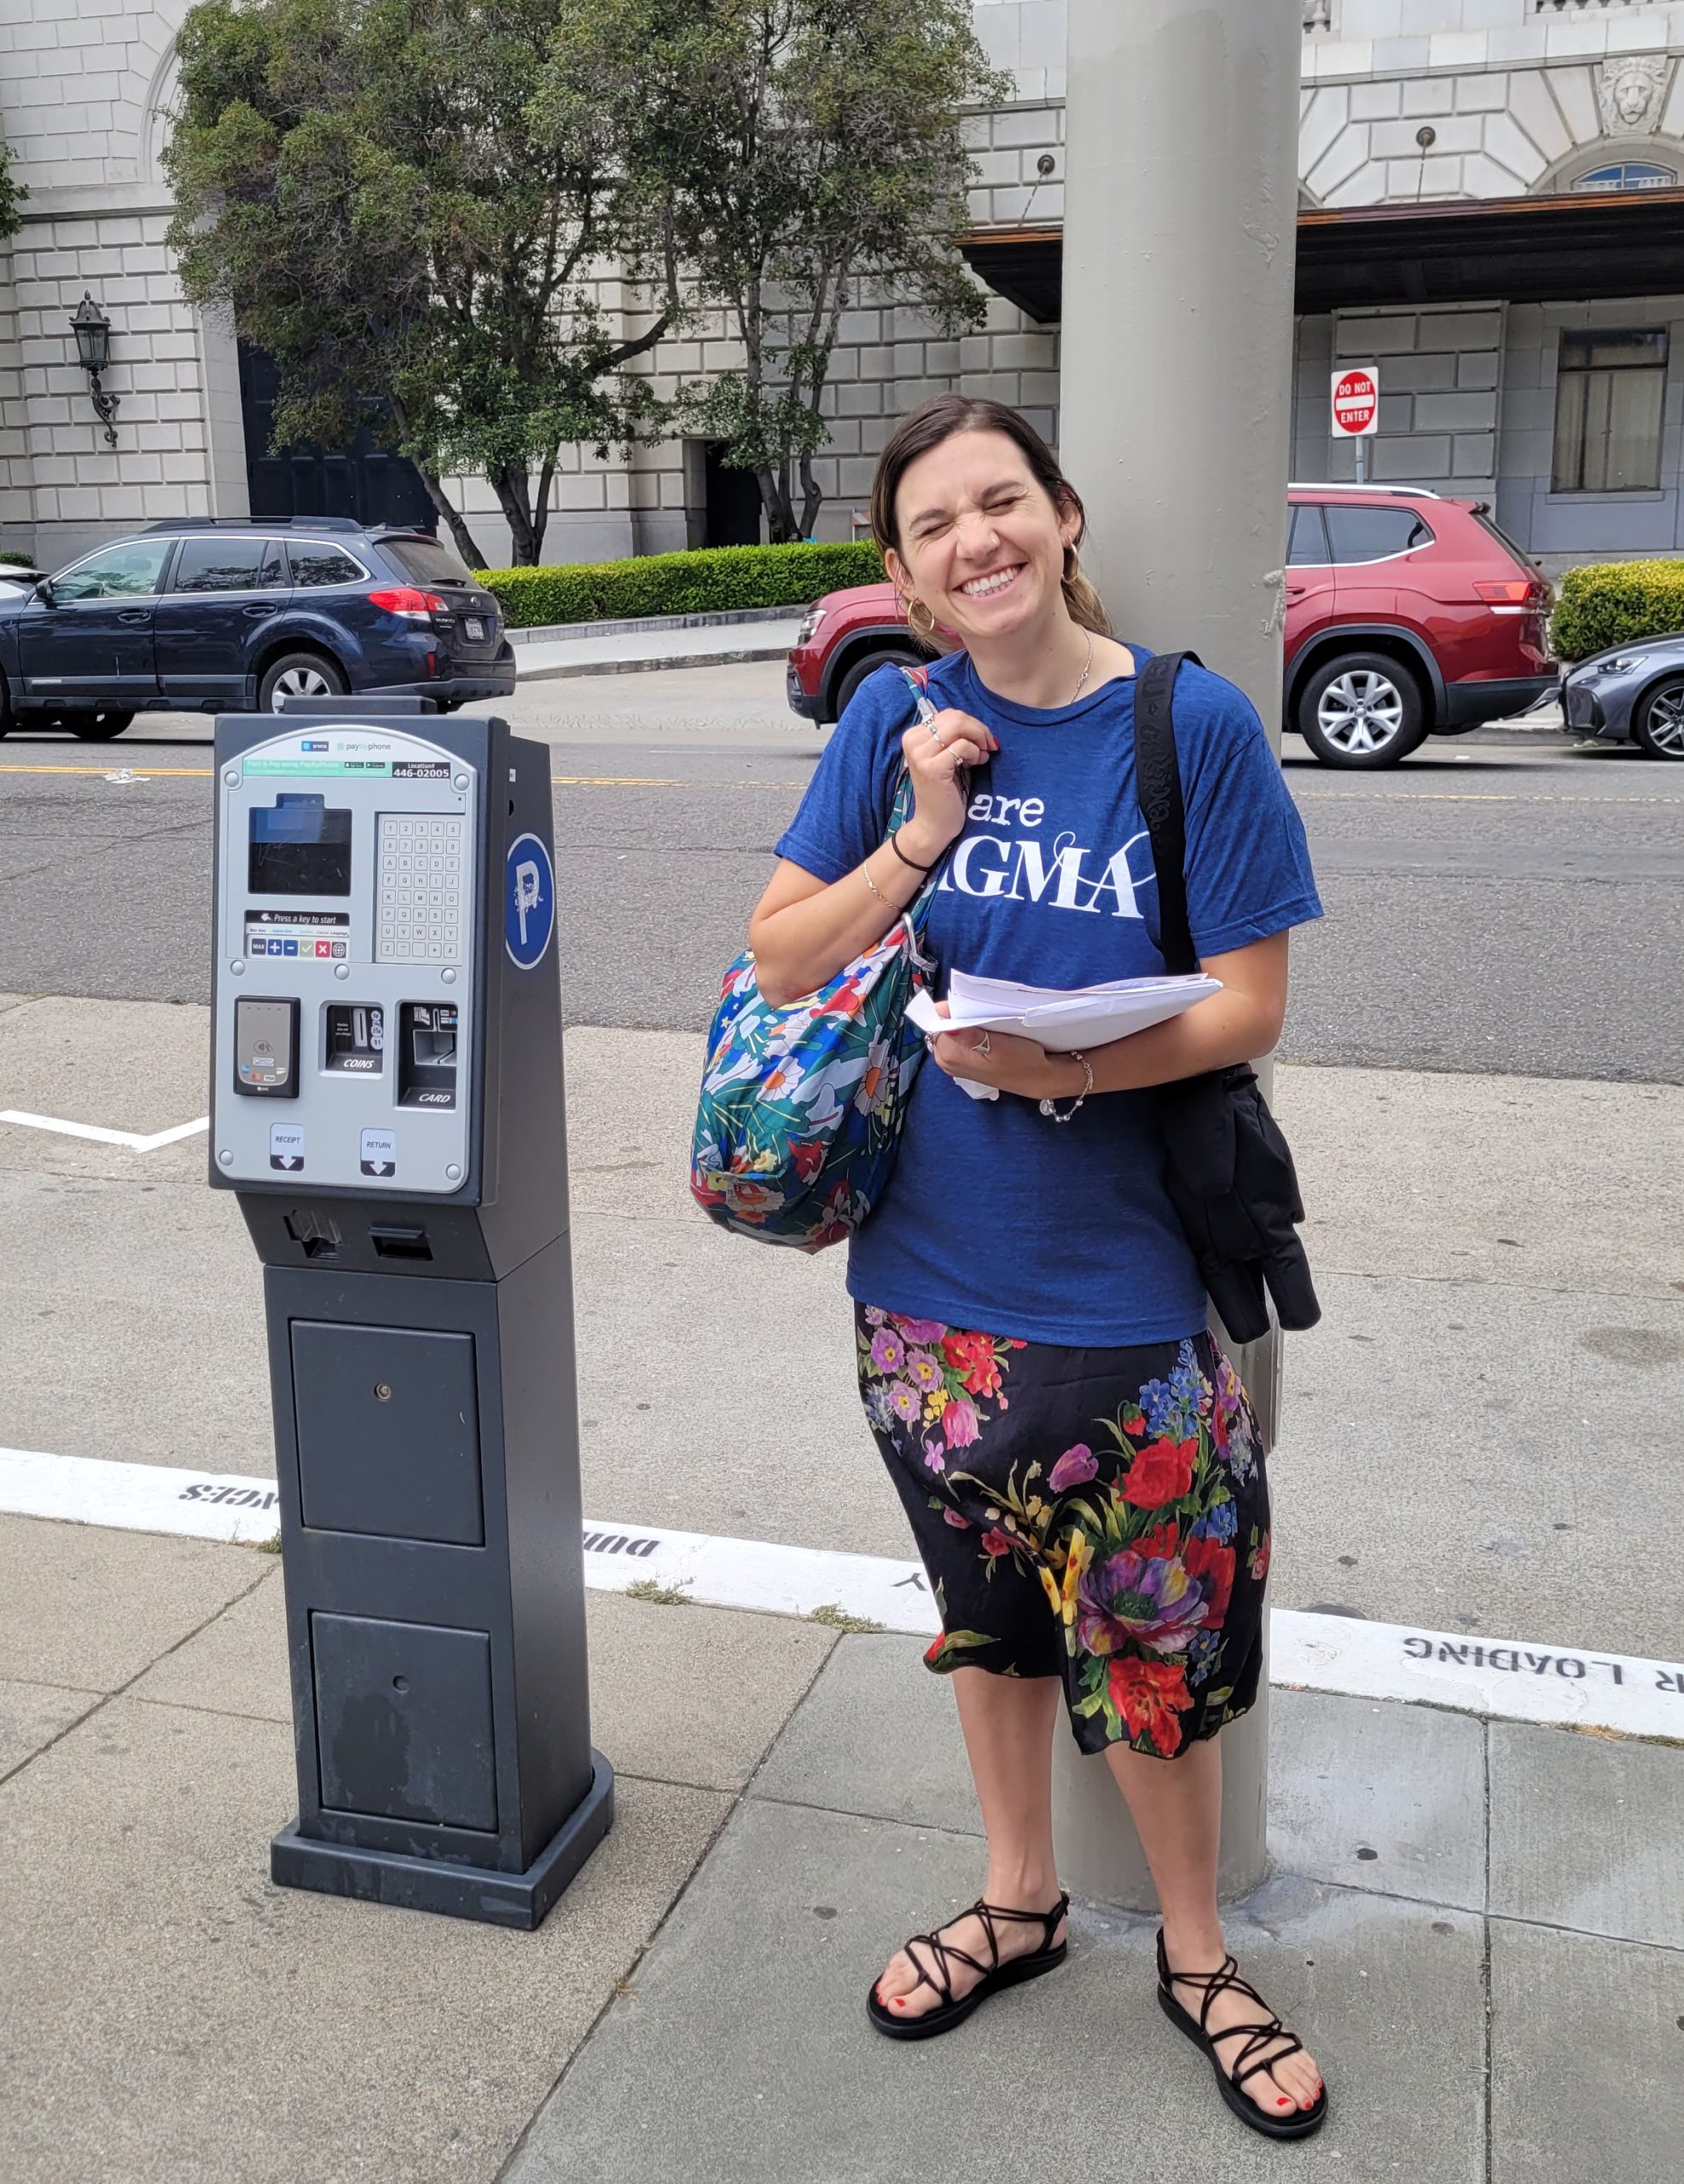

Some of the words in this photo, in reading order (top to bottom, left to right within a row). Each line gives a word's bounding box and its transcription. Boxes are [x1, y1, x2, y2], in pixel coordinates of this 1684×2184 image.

[1339, 383, 1351, 396] DO
[1354, 381, 1371, 394] NOT
[1341, 410, 1369, 423] ENTER
[394, 769, 449, 777] 446-02005
[968, 793, 1045, 827] are
[299, 915, 310, 924] key
[344, 1059, 375, 1068] COINS
[419, 1094, 451, 1103] CARD
[1403, 1636, 1624, 1686] LOADING
